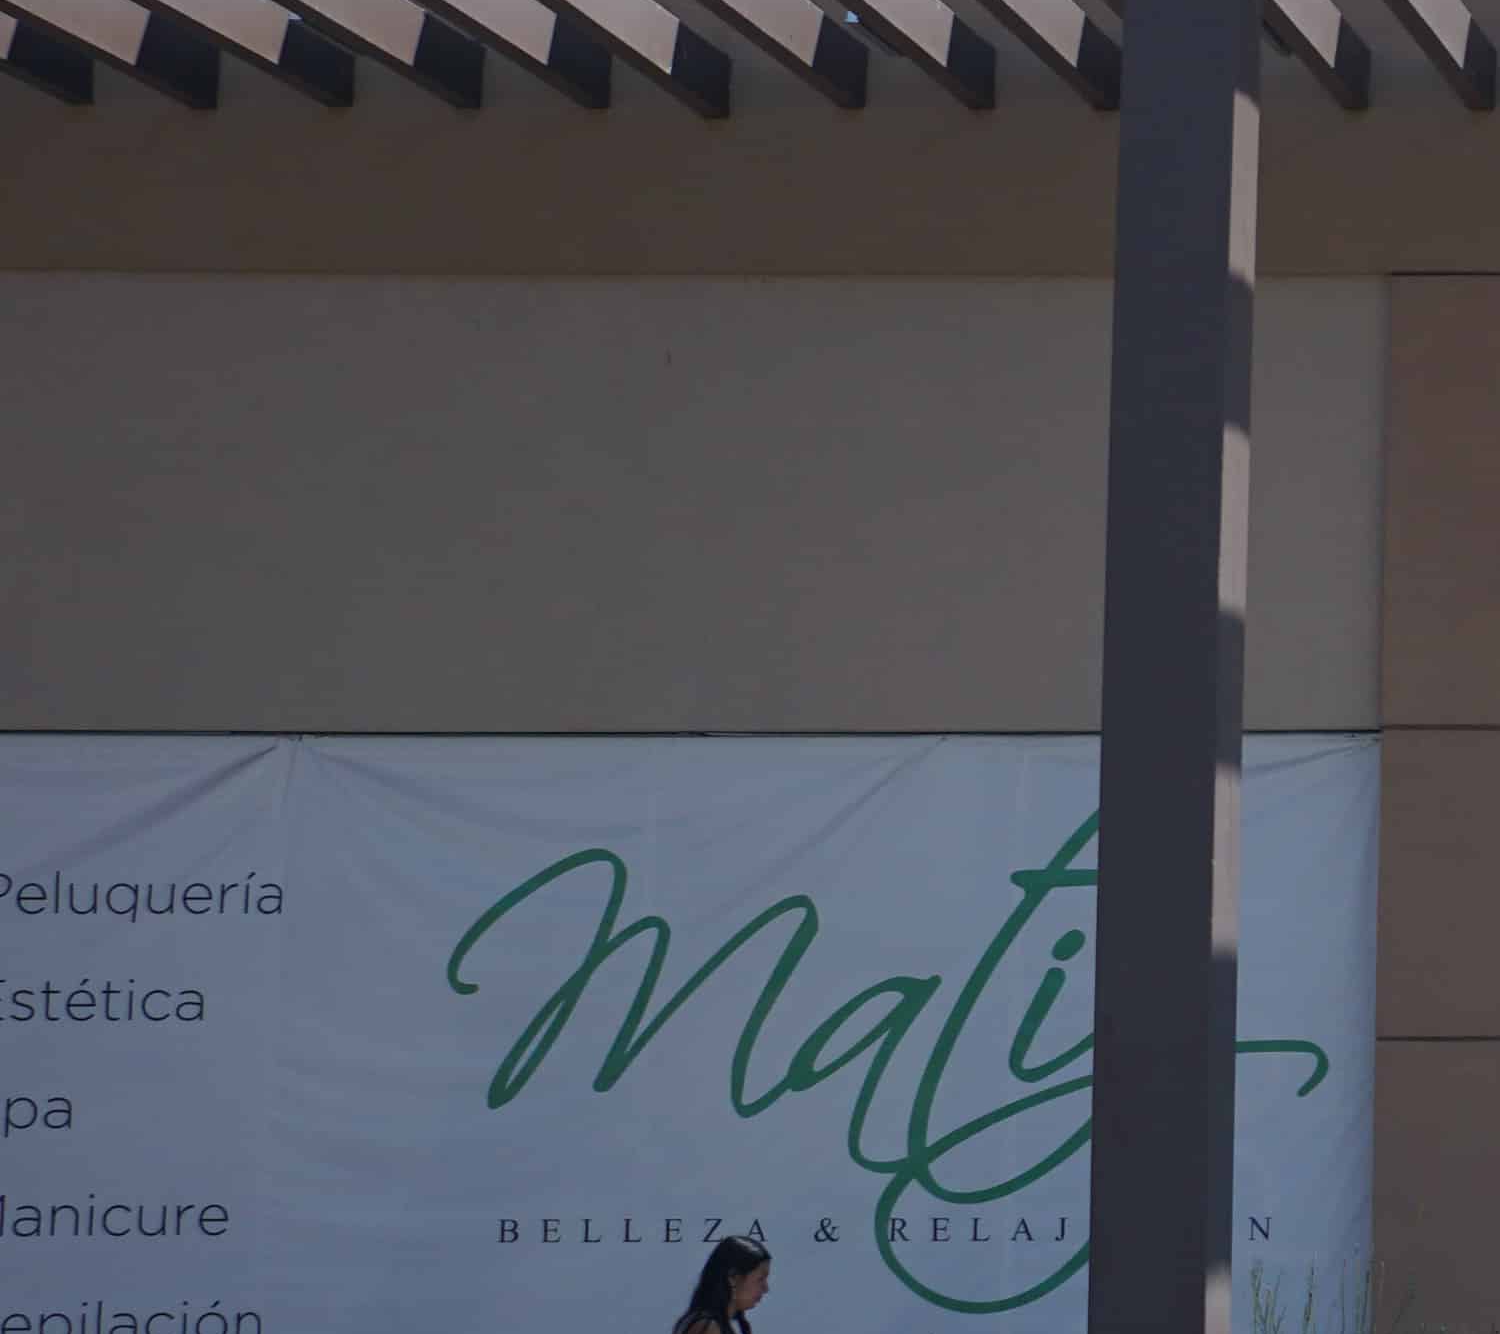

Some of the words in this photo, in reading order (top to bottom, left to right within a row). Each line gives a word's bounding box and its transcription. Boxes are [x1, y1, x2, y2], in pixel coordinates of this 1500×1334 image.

[0, 1193, 229, 1237] anicure
[498, 1218, 768, 1243] BELLEZA
[813, 1217, 841, 1243] &
[888, 1216, 1272, 1243] RELAJN
